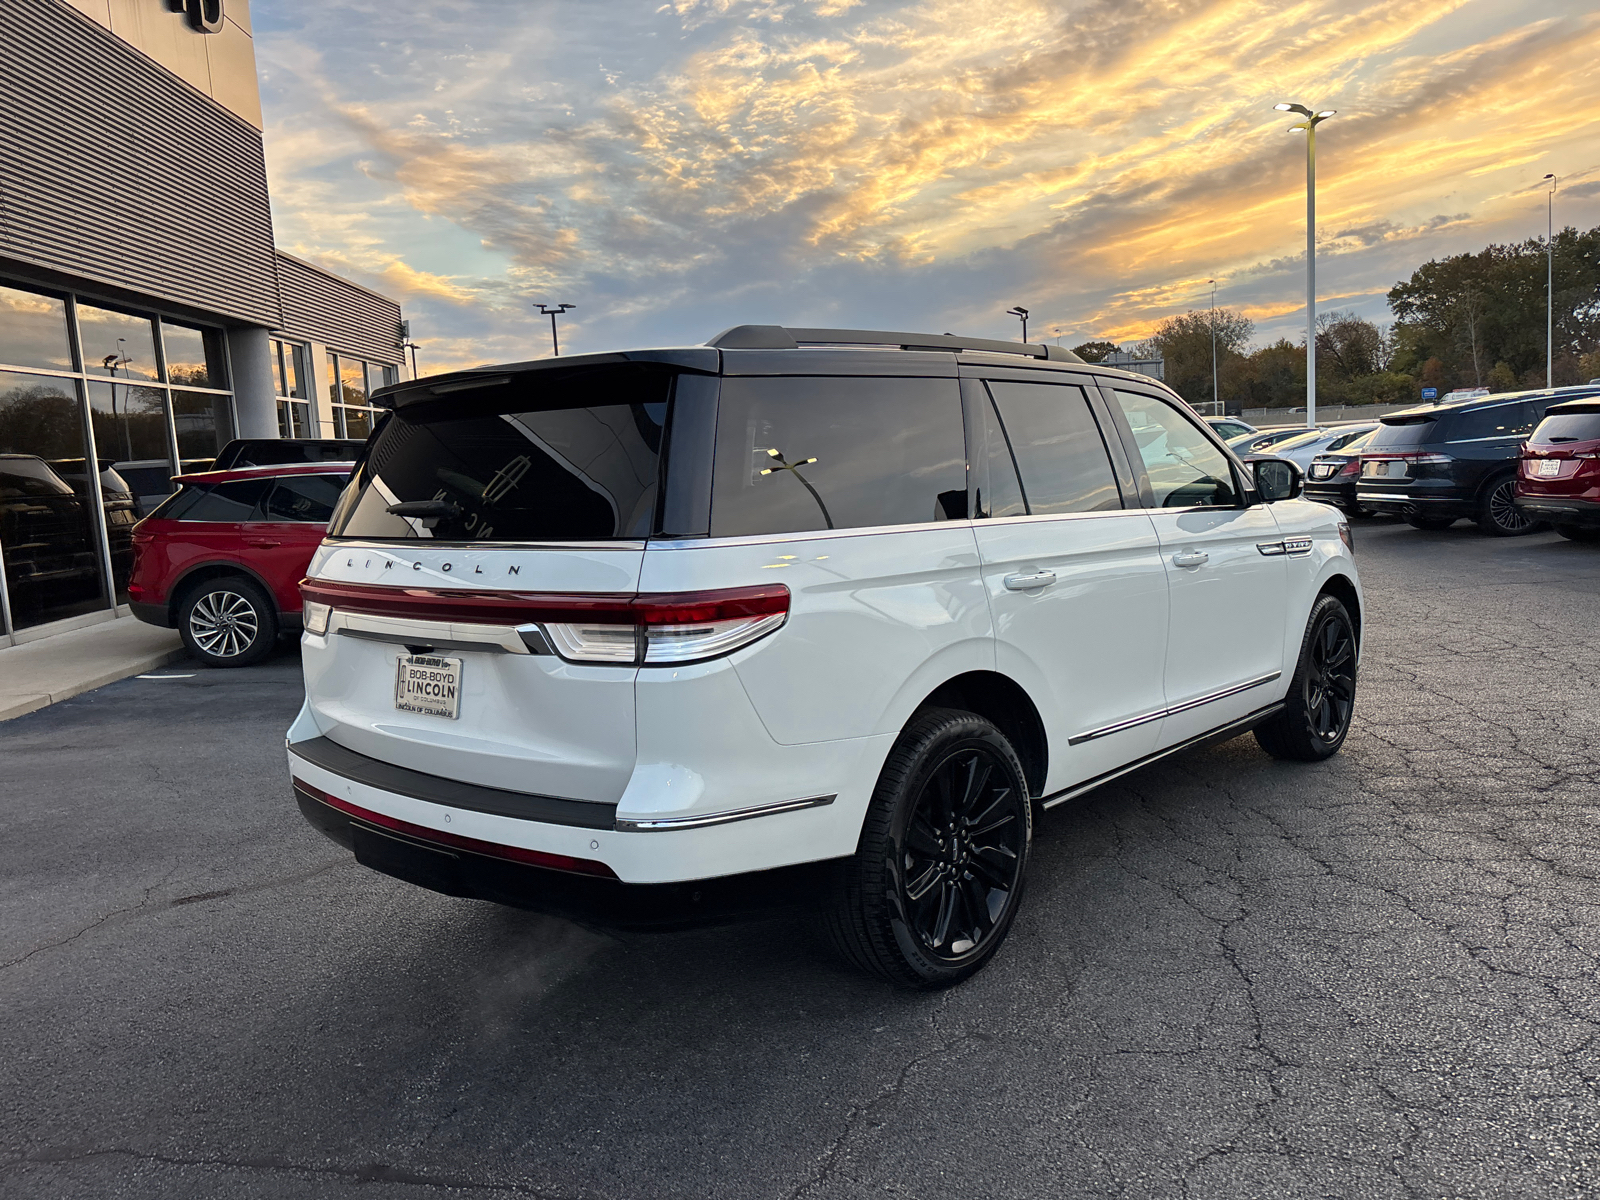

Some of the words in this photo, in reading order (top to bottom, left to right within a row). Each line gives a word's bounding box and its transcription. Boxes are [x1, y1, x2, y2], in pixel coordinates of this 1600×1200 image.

[347, 558, 520, 575] LINCOLN
[410, 669, 454, 684] BOB-BOYD
[407, 680, 455, 699] LINCOLN
[425, 708, 453, 718] COLUMBUS
